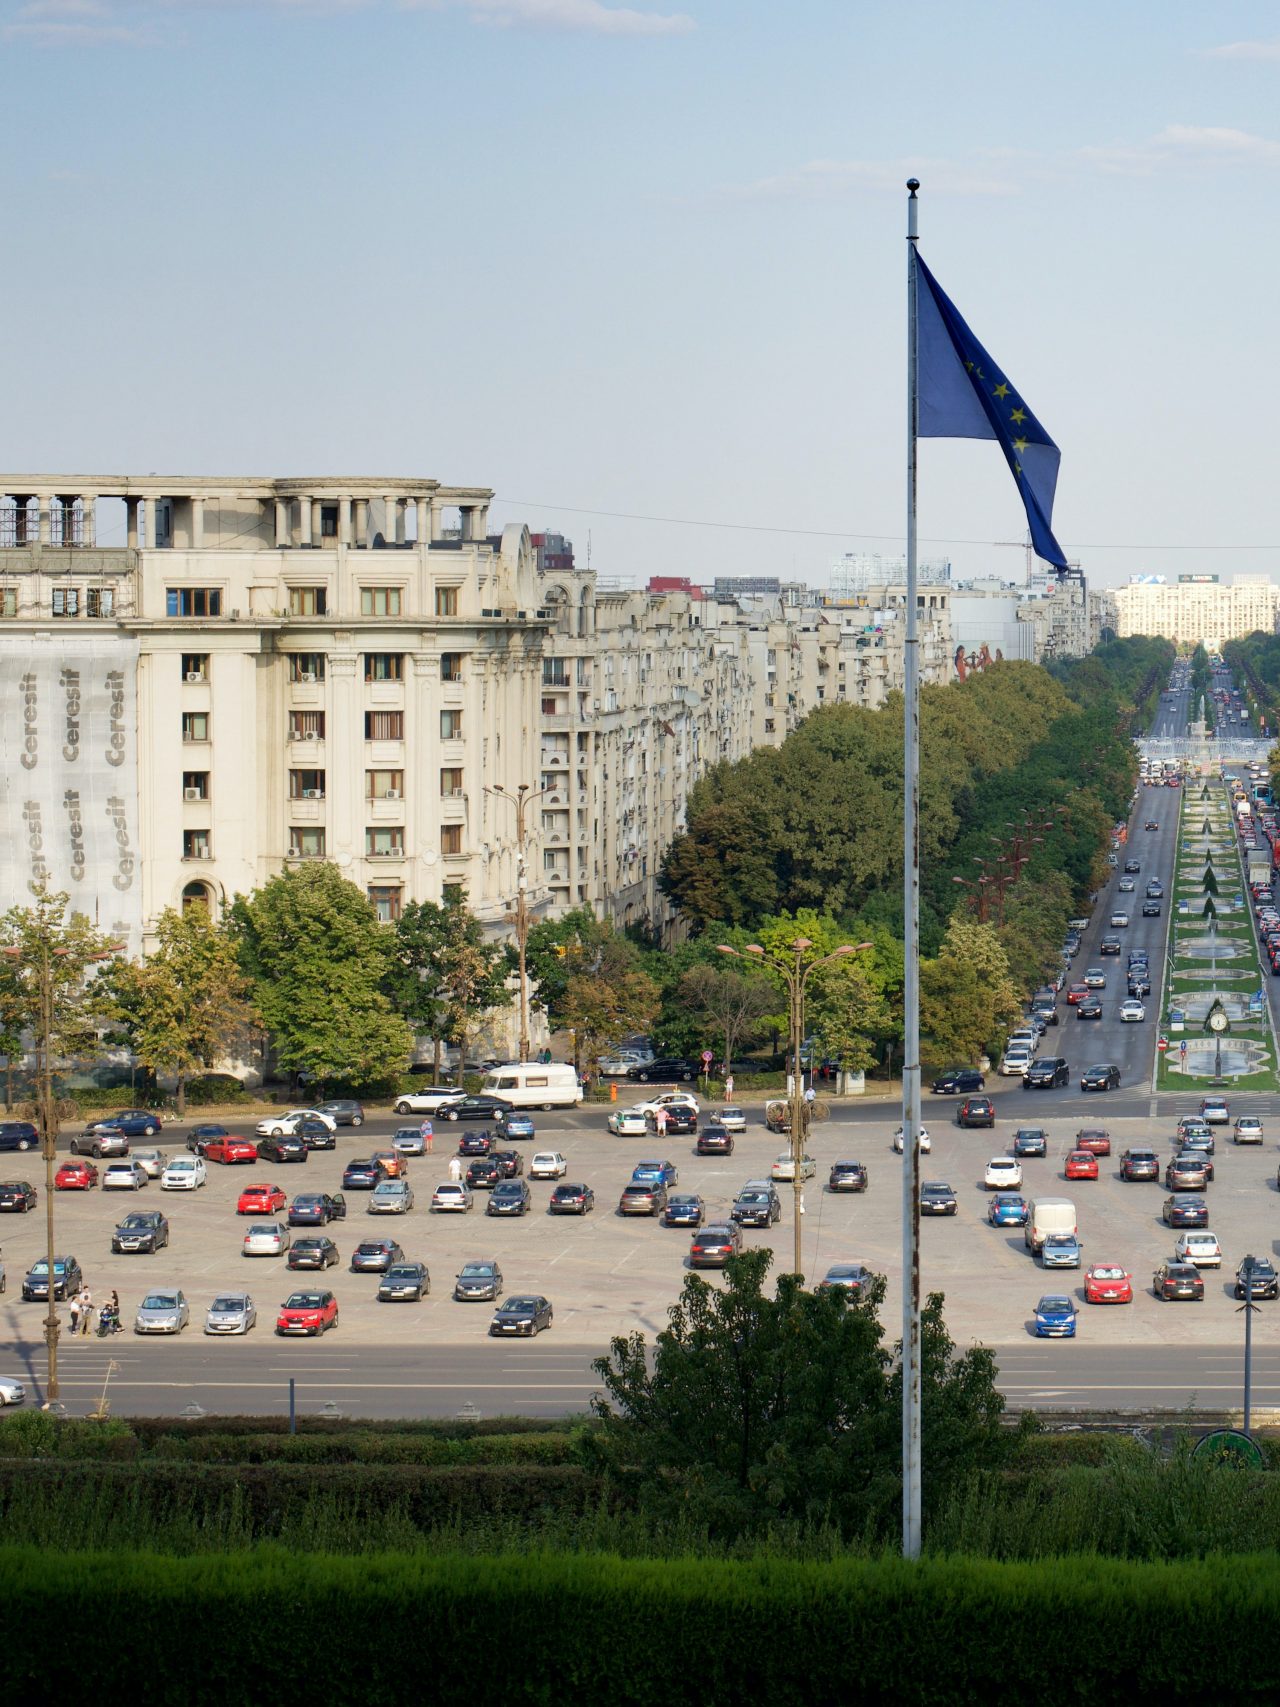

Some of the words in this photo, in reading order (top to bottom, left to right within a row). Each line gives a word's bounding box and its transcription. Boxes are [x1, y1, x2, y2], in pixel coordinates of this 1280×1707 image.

[19, 673, 38, 770] Ceresit
[59, 669, 80, 762] Ceresit
[105, 671, 125, 766] Ceresit
[63, 790, 85, 881] Ceresit
[105, 796, 135, 891] Ceresit
